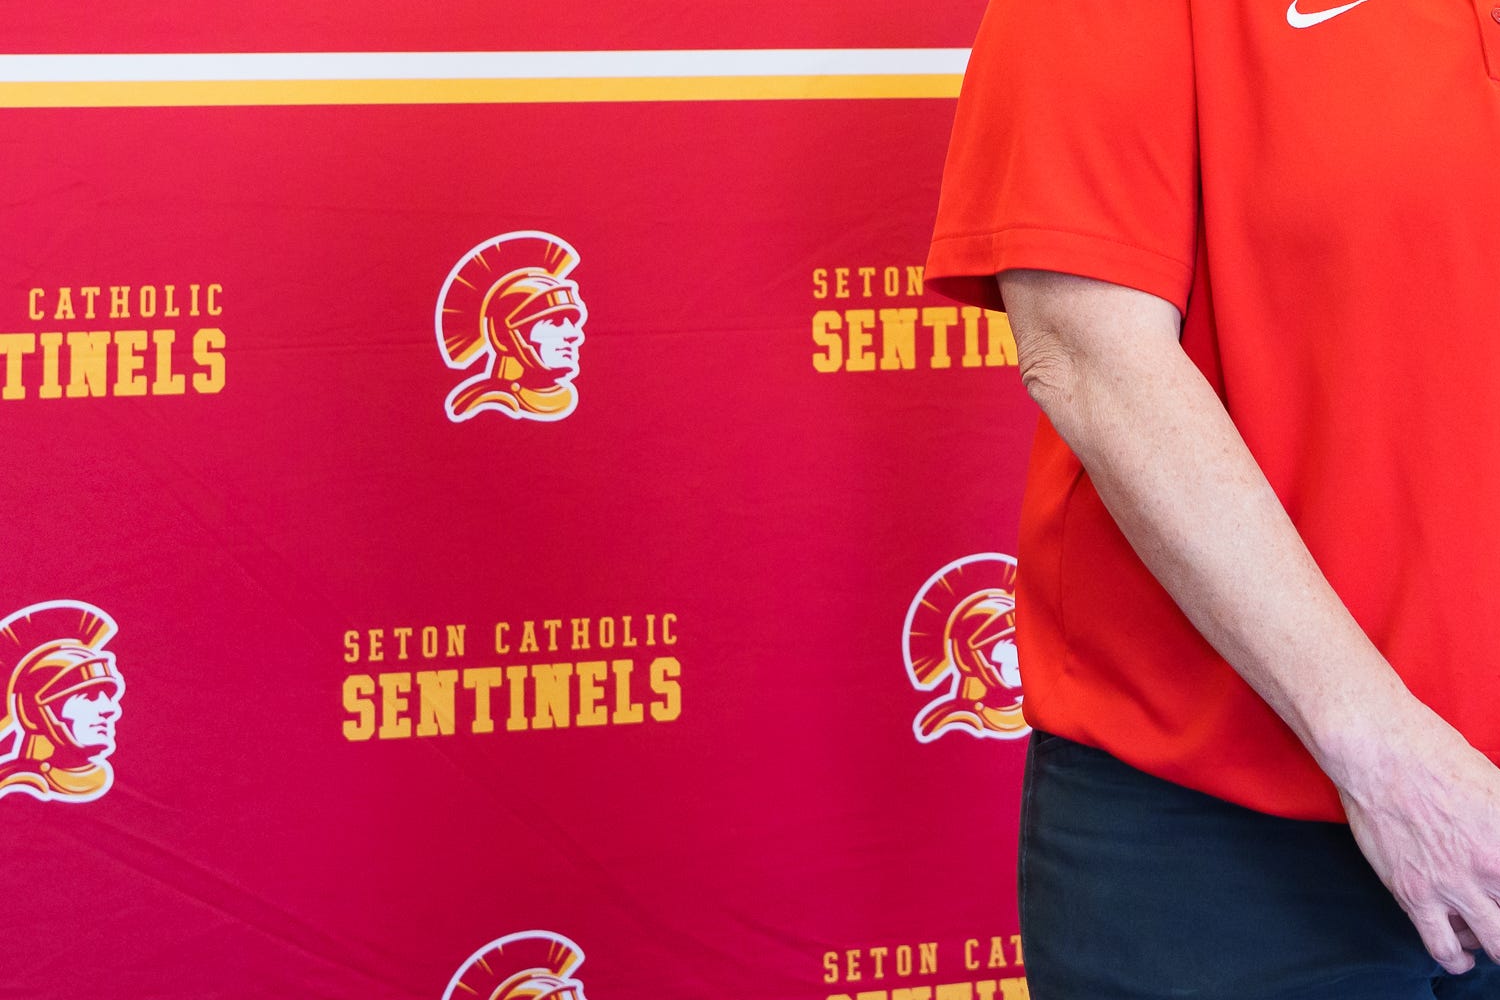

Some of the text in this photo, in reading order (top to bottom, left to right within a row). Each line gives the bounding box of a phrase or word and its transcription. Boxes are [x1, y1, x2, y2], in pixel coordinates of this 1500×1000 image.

[28, 283, 223, 321] CATHOLIC
[812, 266, 925, 299] SETON
[0, 327, 227, 400] TINELS
[343, 613, 678, 662] SETON CATHOLIC
[342, 656, 682, 742] SENTINELS
[823, 934, 1025, 984] SETON CAT
